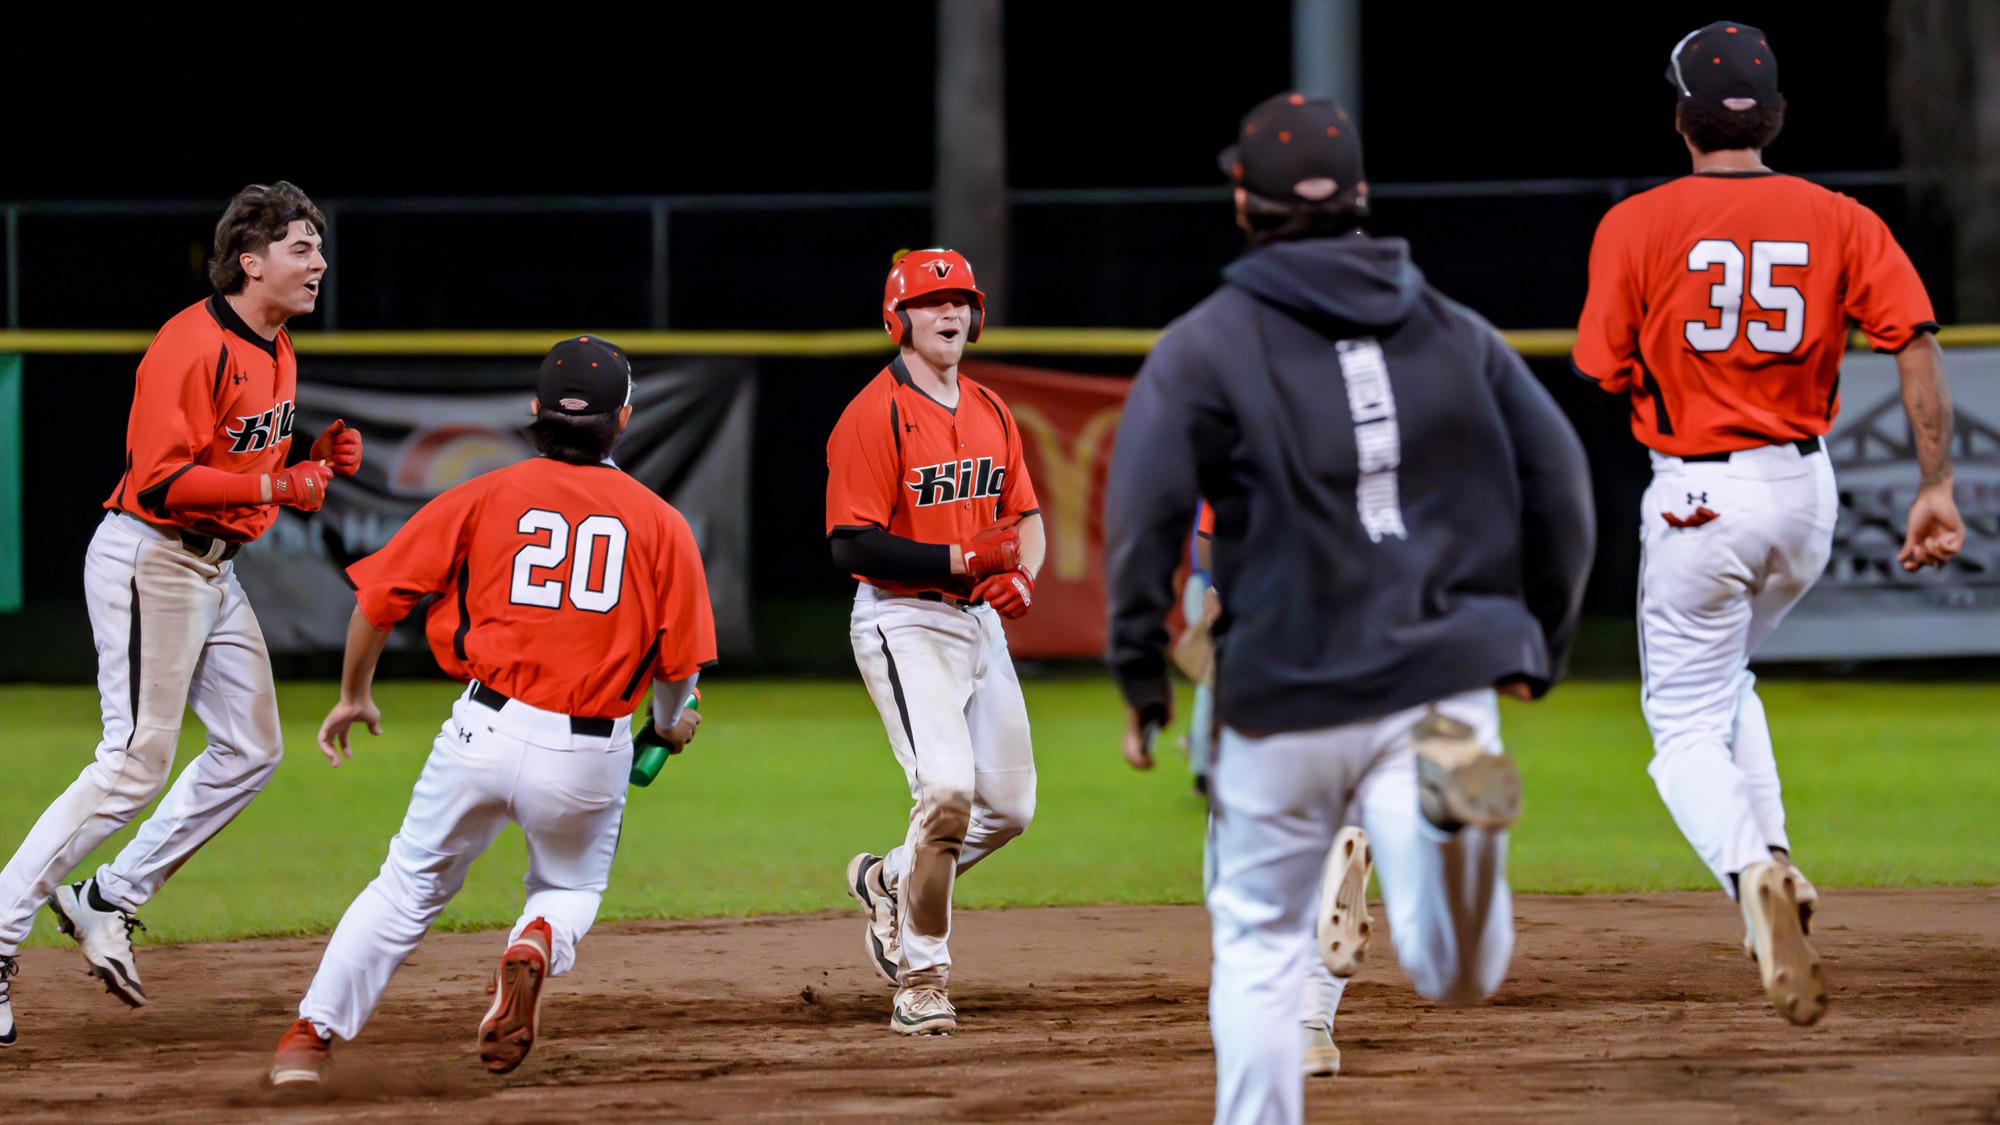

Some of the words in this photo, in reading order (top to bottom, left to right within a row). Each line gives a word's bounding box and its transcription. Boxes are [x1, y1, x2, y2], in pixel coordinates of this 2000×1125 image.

[1684, 239, 1809, 354] 35
[904, 456, 1006, 507] Hilo
[509, 508, 629, 614] 20
